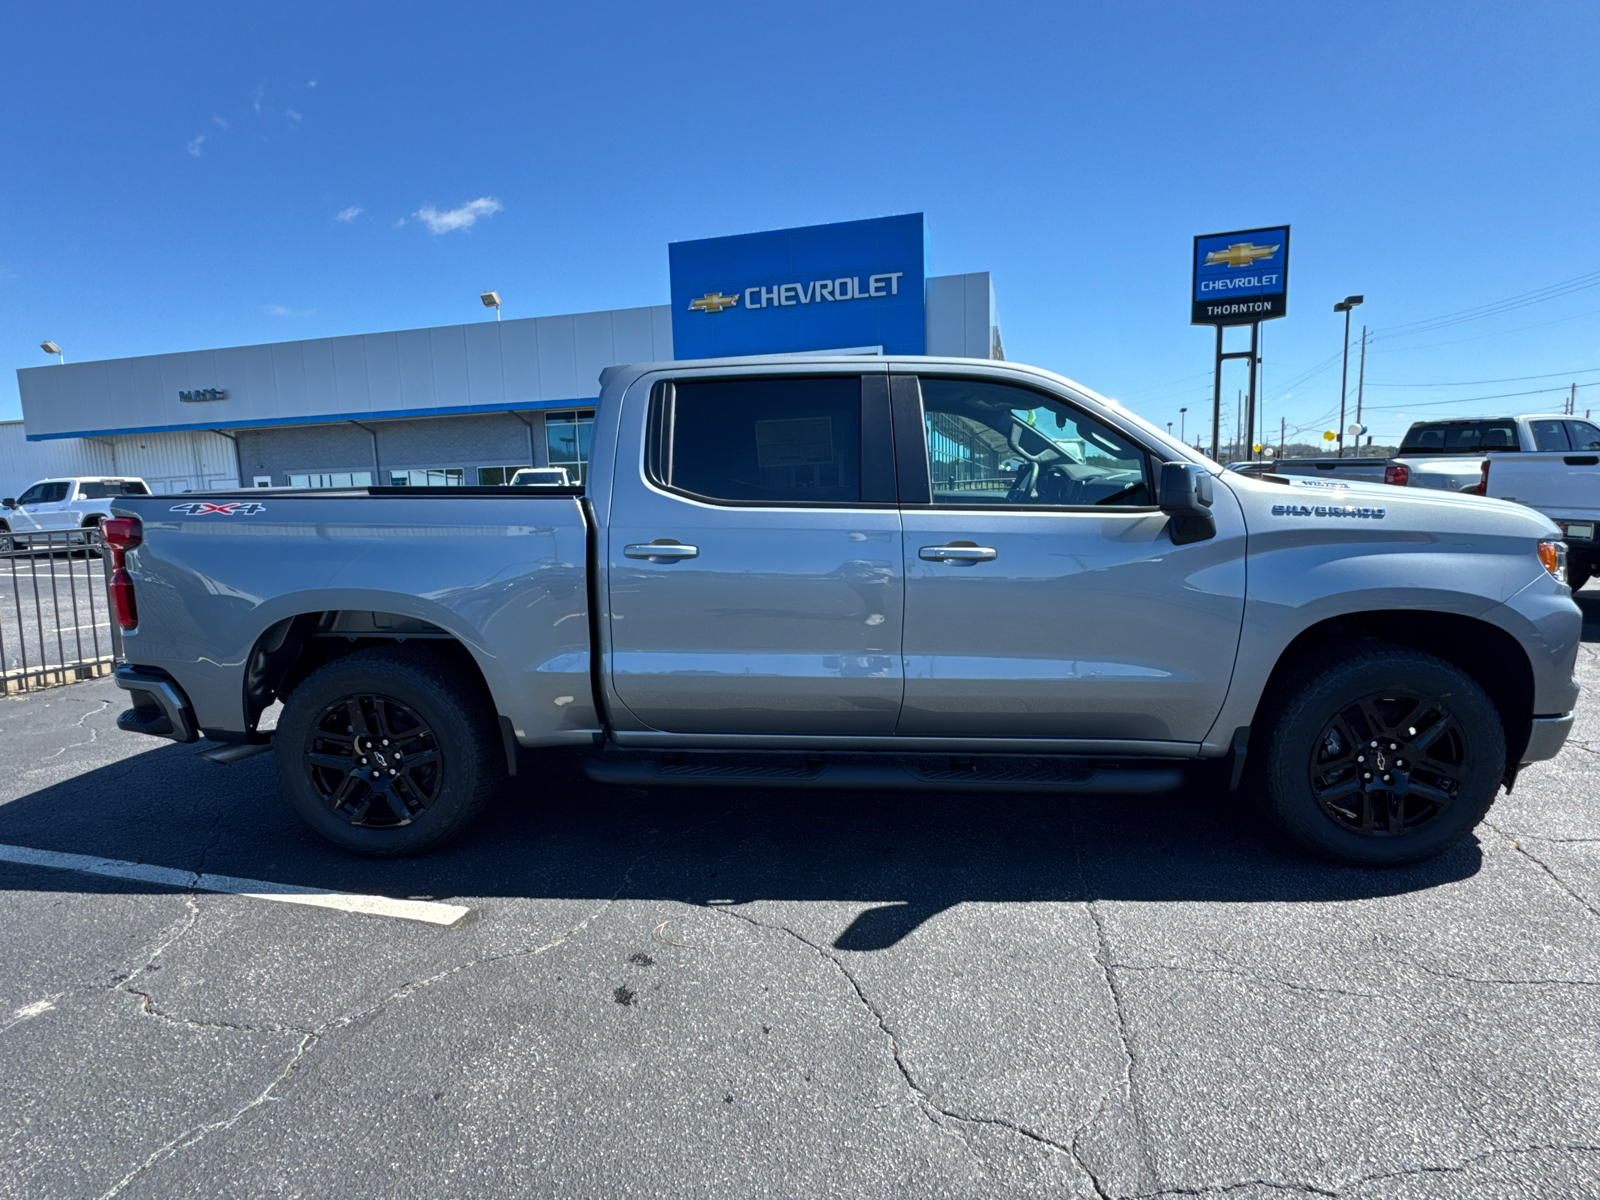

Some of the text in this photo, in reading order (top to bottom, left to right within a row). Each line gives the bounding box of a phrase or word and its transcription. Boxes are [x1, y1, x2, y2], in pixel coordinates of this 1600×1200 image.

[1201, 274, 1279, 291] CHEVROLET
[744, 272, 903, 309] CHEVROLET
[1207, 302, 1272, 315] THORNTON
[178, 388, 218, 402] PARTS
[1271, 505, 1386, 519] SILVERADO
